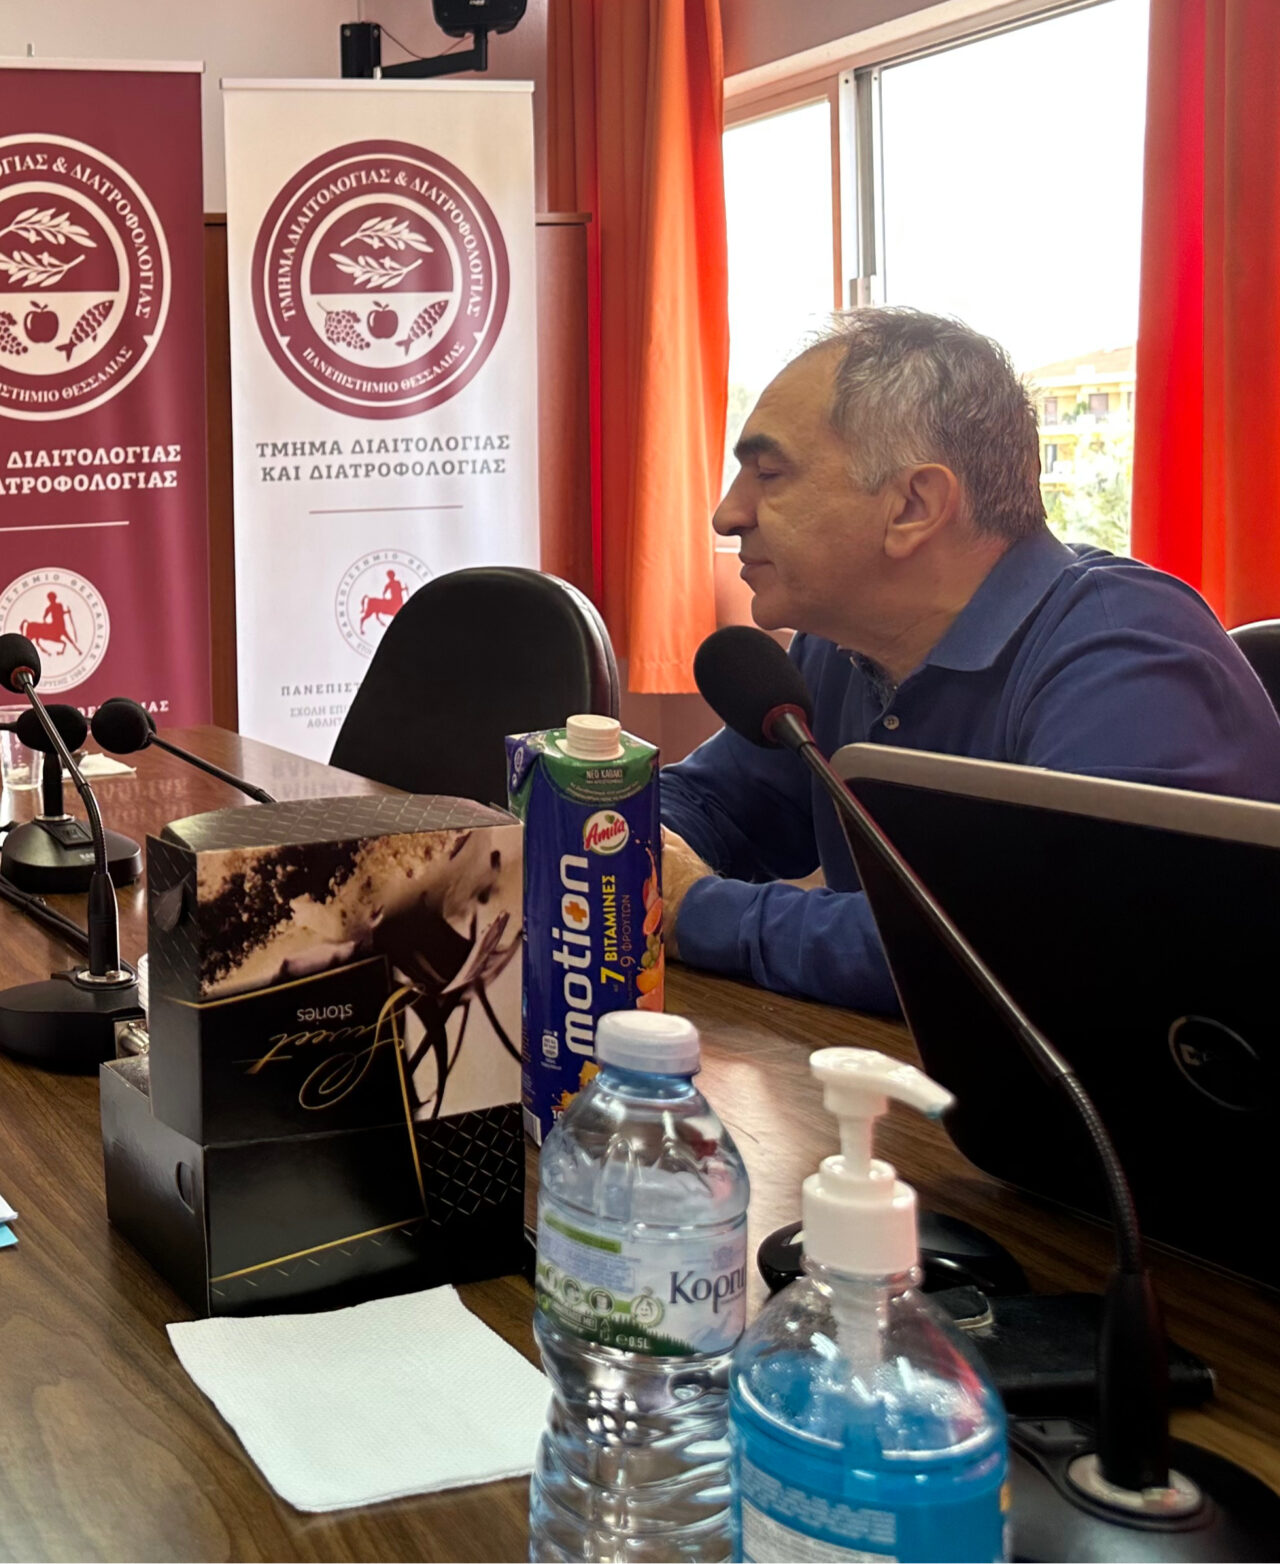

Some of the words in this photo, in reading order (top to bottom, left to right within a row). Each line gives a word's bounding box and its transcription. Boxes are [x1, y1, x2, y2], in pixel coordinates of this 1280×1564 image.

[393, 170, 409, 186] &
[287, 168, 391, 245] ΔΙΑΙΤΟΛΟΓΙΑΣ
[52, 156, 68, 174] &
[71, 163, 154, 319] ΔΙΑΤΡΟΦΟΛΟΓΙΑΣ
[409, 176, 485, 318] ΔΙΑΤΡΟΦΟΛΟΓΙΑΣ
[278, 246, 297, 322] ΤΜΗΜΑ
[62, 346, 133, 399] ΘΕΣΣΑΛΙΑΣ
[302, 347, 399, 393] ΠΑΝΕΠΙΣΤΗΜΙΟ
[400, 341, 466, 392] ΘΕΣΣΑΛΙΑΣ
[6, 445, 181, 469] ΔΙΑΙΤΟΛΟΓΙΑΣ
[256, 440, 344, 458] ΤΜΗΜΑ
[350, 434, 510, 455] ΔΙΑΙΤΟΛΟΓΙΑΣ
[261, 465, 301, 482] ΚΑΙ
[309, 458, 506, 481] ΔΙΑΤΡΟΦΟΛΟΓΙΑΣ
[584, 818, 625, 850] Amita
[601, 874, 618, 962] ΒΙΤΑΜΙΝΕΣ
[621, 894, 633, 952] ΦΡΟΥΤΩΝ
[552, 854, 594, 1057] motion
[600, 966, 625, 985] 7
[620, 956, 636, 968] 9
[296, 1003, 353, 1025] stories
